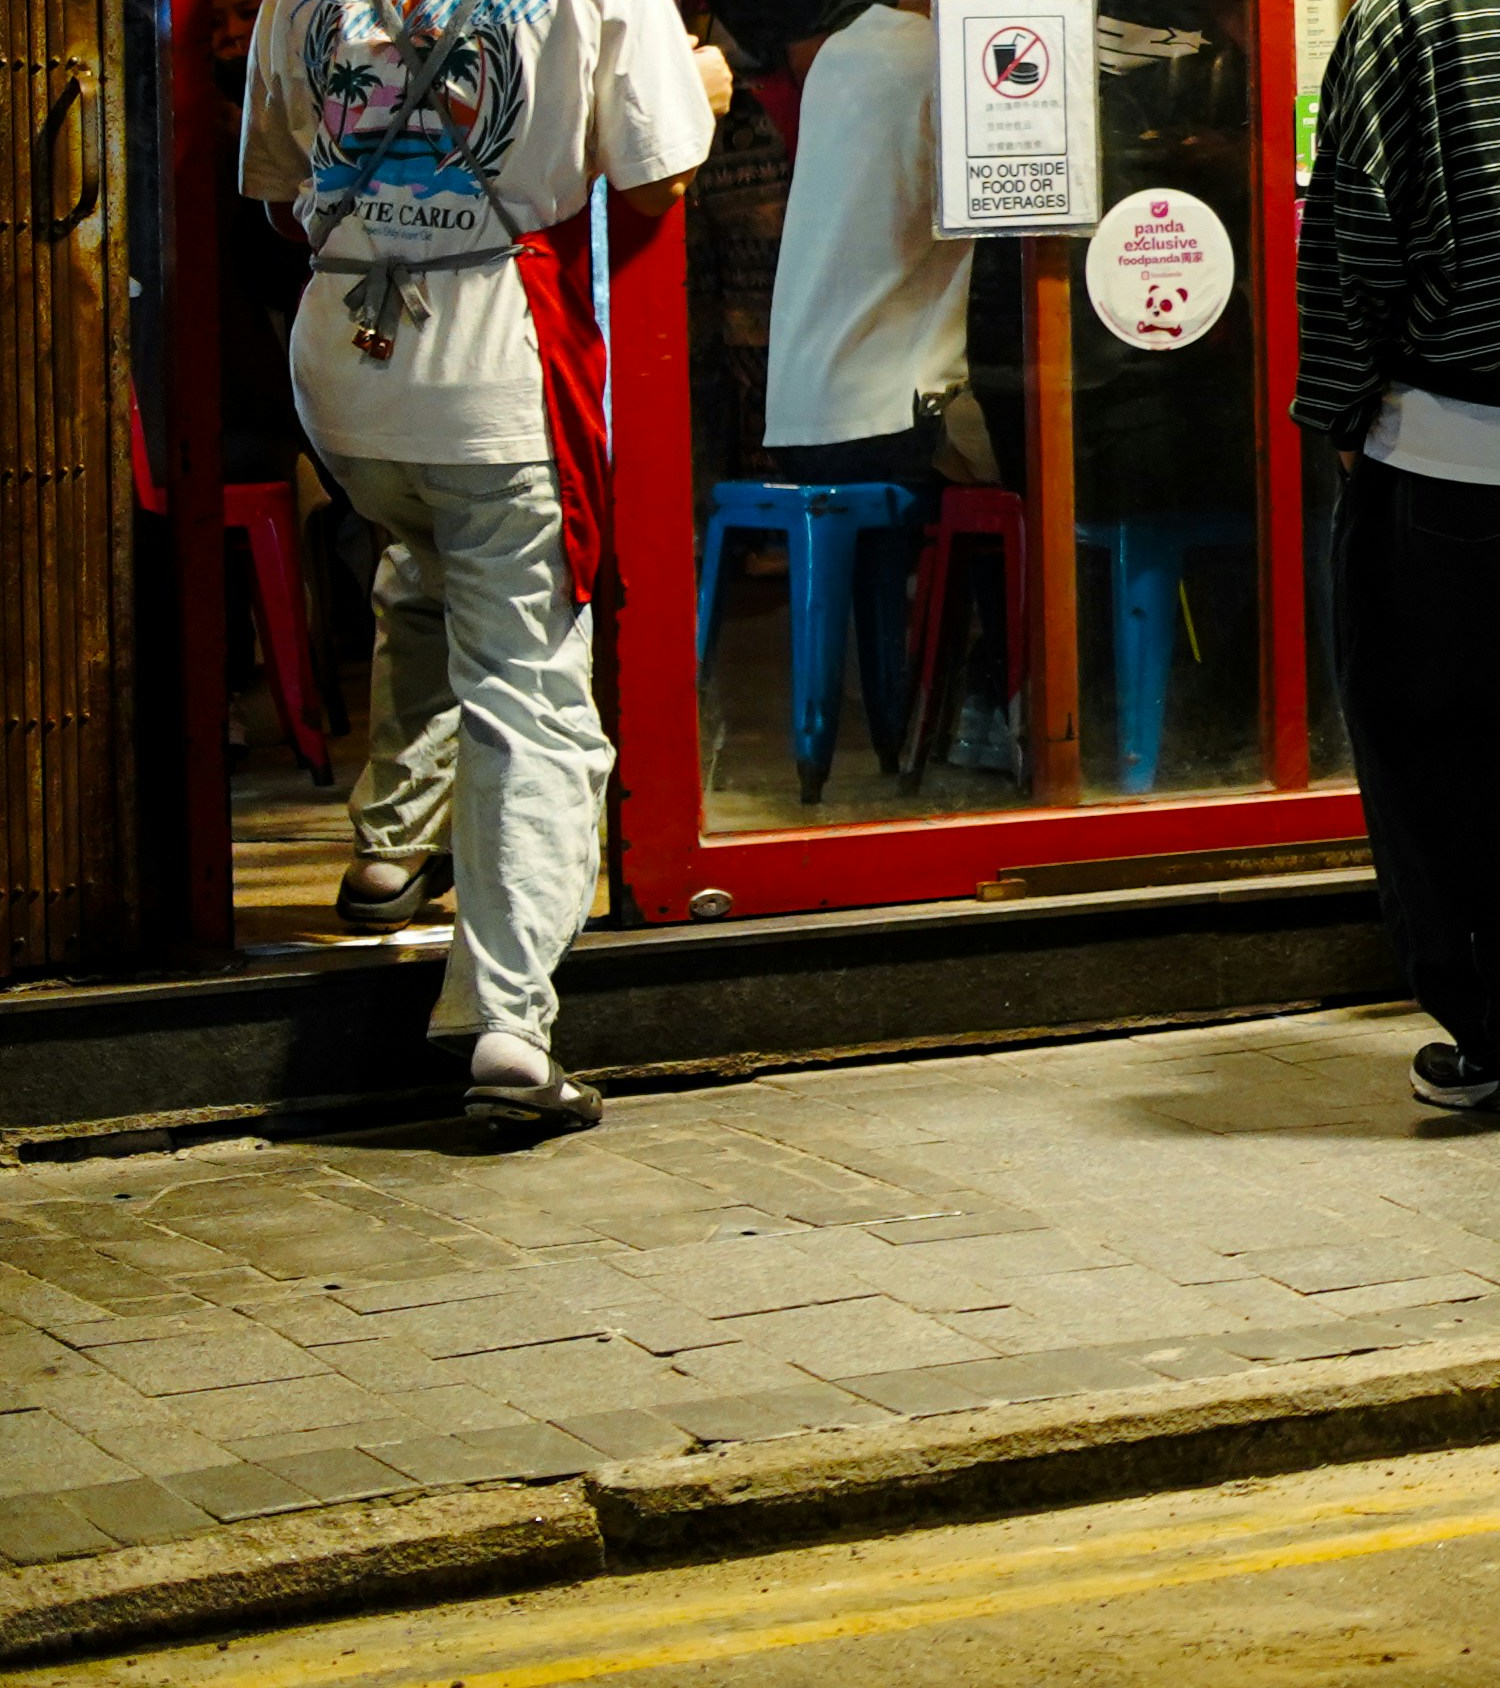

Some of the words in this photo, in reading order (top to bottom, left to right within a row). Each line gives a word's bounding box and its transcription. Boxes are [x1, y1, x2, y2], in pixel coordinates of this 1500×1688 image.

[969, 163, 993, 180] NO
[997, 161, 1066, 179] OUTSIDE
[982, 179, 1026, 195] FOOD
[1029, 177, 1054, 192] OR
[971, 194, 1067, 213] BEVERAGES
[398, 204, 476, 230] CARLO
[1134, 219, 1186, 237] panda
[1123, 235, 1198, 252] exclusive
